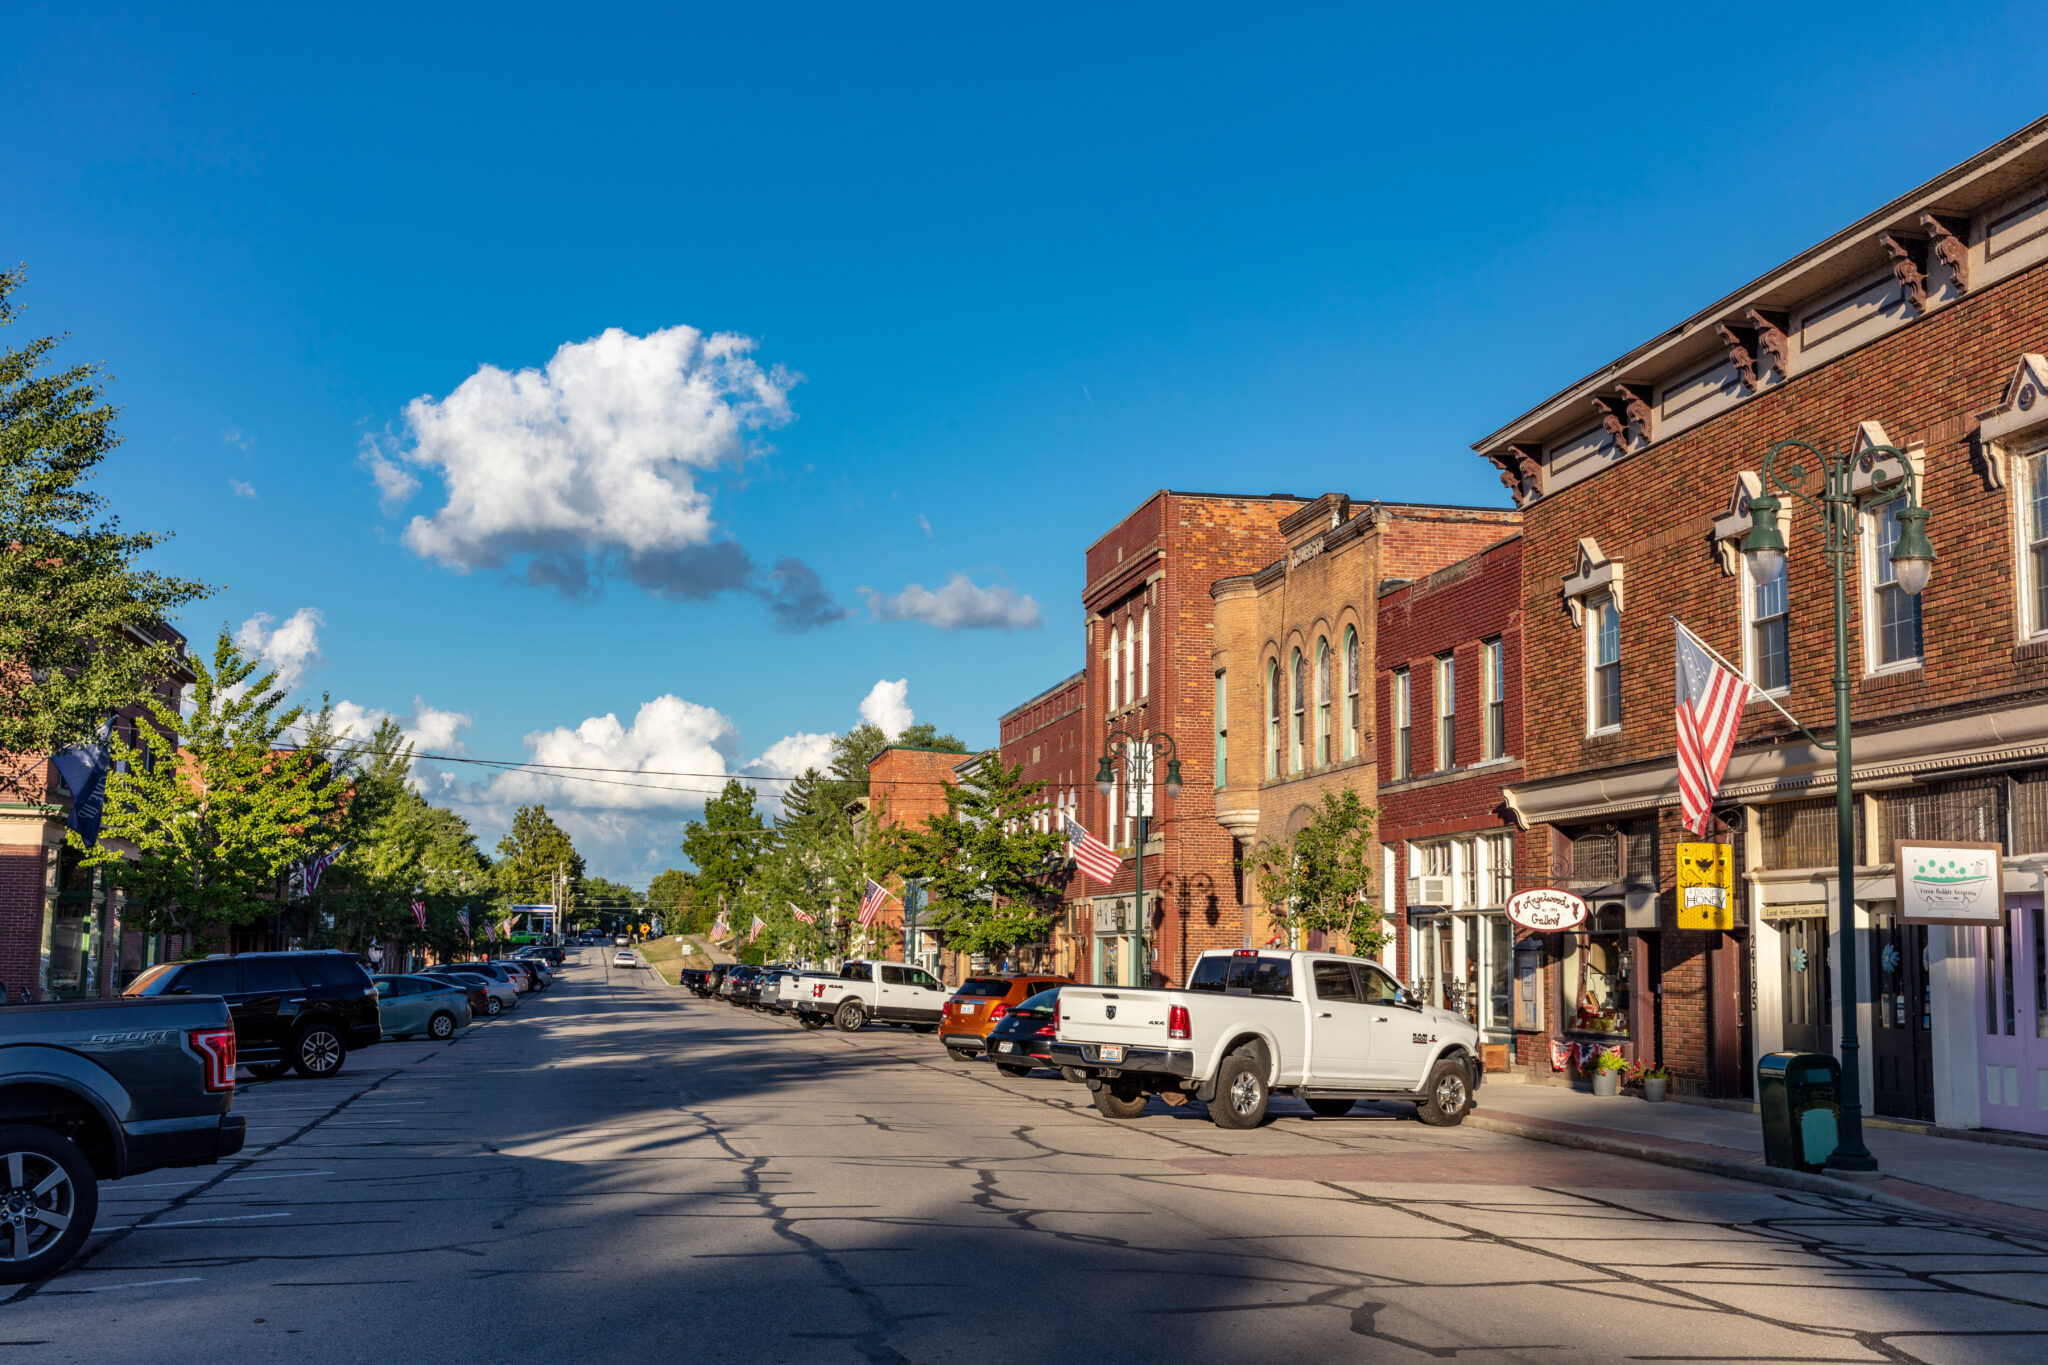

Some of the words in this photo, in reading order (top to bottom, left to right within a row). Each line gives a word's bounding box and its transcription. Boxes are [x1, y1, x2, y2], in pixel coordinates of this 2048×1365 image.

[1523, 892, 1570, 909] Angelwood
[1687, 896, 1726, 908] HONEY
[1749, 934, 1757, 1011] 24195
[81, 1029, 178, 1047] SPORT
